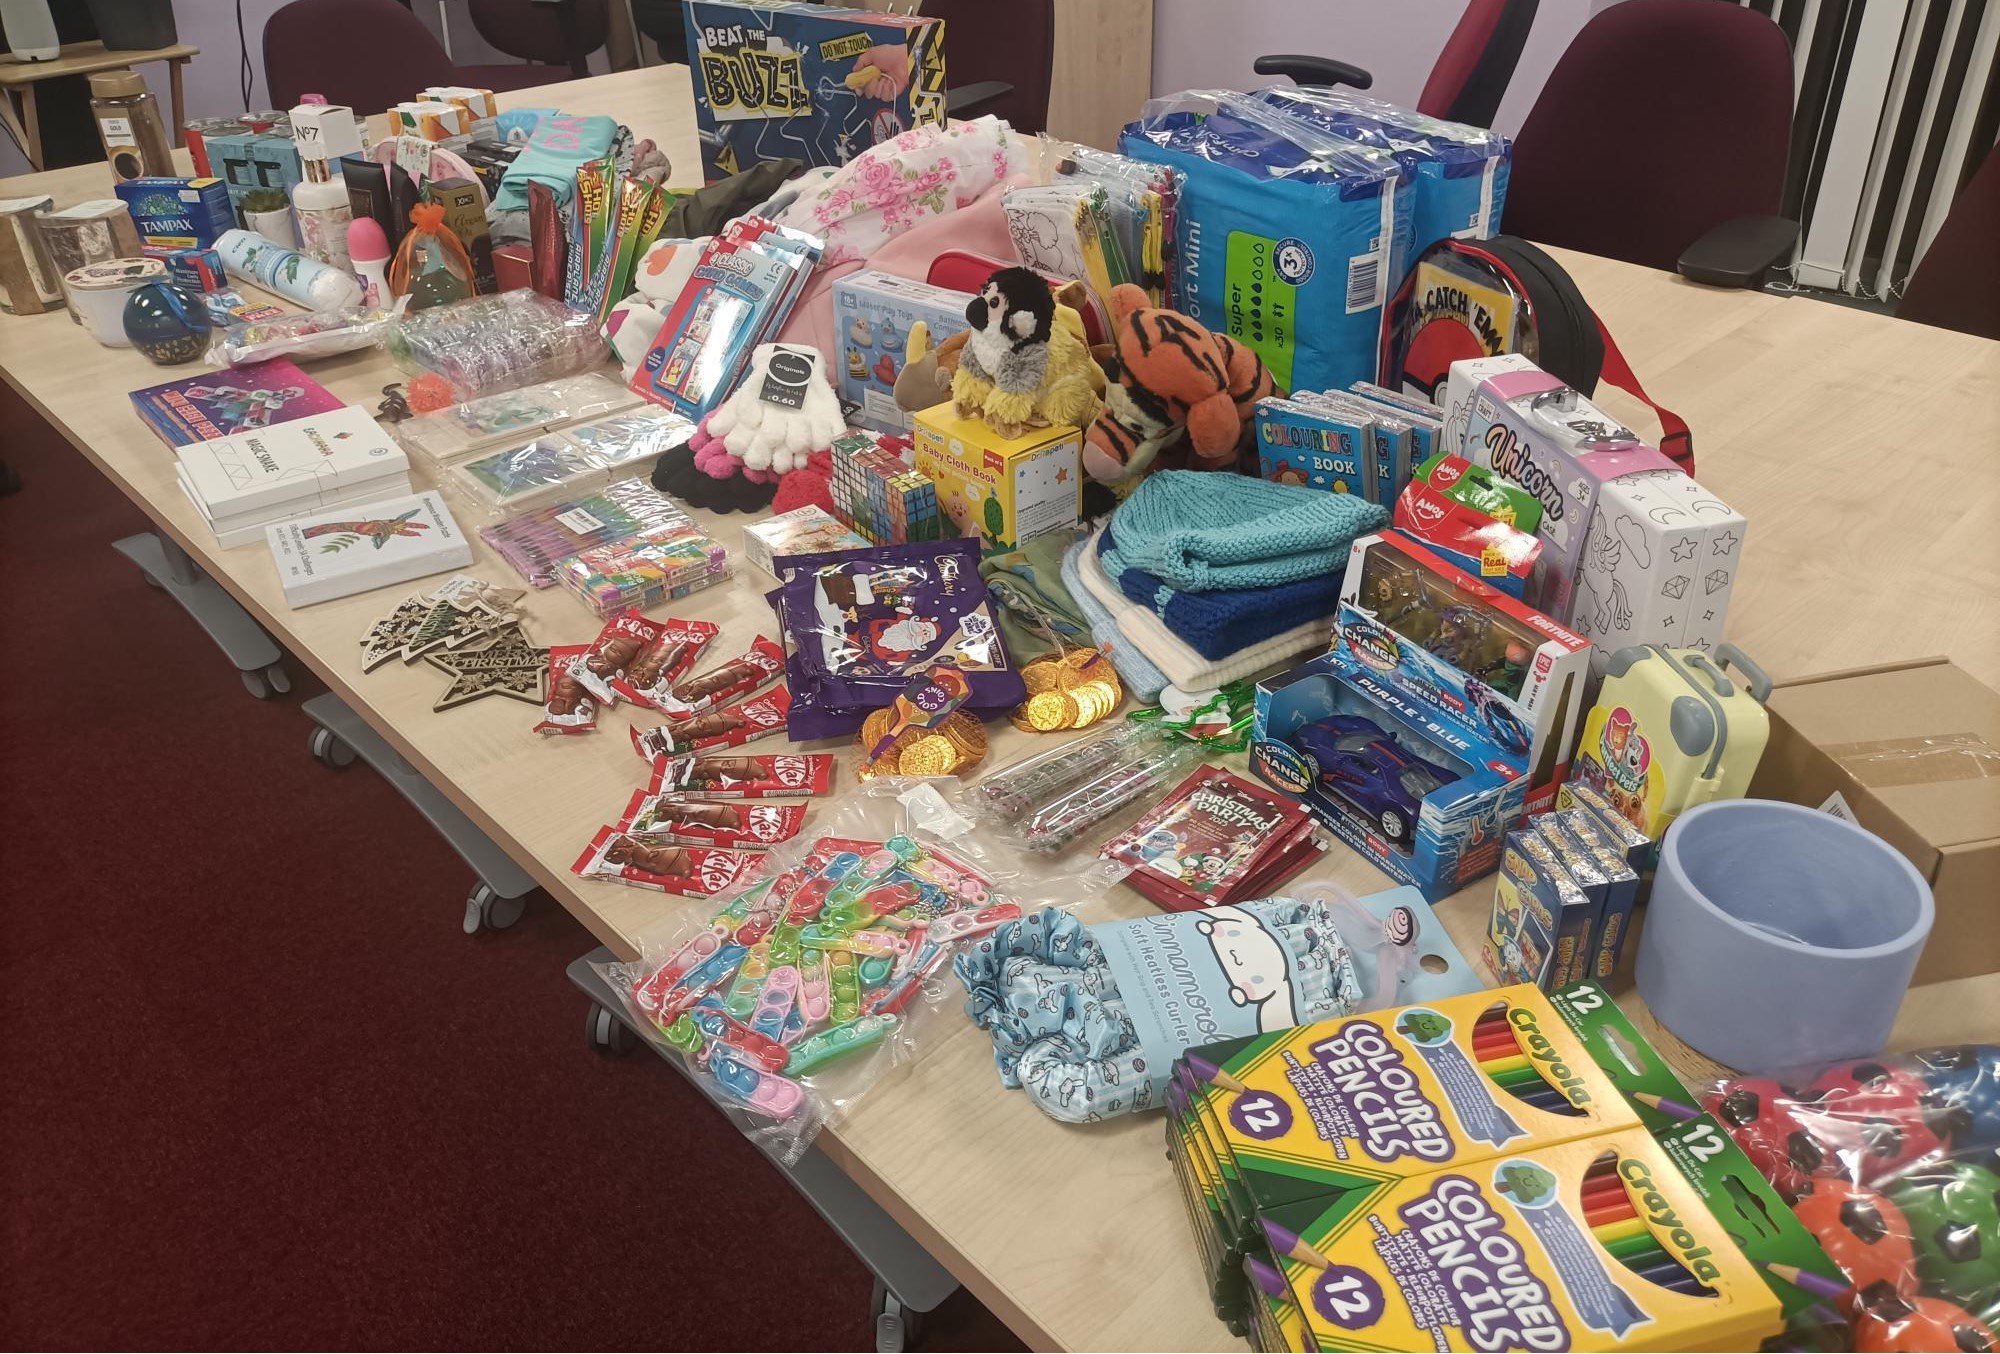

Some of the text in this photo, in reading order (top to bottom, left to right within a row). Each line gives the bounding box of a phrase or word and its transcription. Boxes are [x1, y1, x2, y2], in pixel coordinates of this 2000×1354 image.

[706, 25, 765, 47] BEAT THE
[822, 37, 873, 58] DO NOT TOUCH
[703, 51, 809, 109] BUZZ
[141, 218, 194, 233] TAMPAX
[717, 254, 754, 276] CLASSIC
[1186, 219, 1201, 277] Mini
[1275, 240, 1295, 255] SECURE
[571, 243, 583, 305] AIRPLANE
[725, 274, 764, 300] GAMES
[882, 305, 897, 318] Play
[898, 309, 913, 320] Toys
[1232, 283, 1243, 336] Super
[1426, 287, 1468, 315] CATCH
[775, 363, 805, 375] Originals
[1262, 422, 1354, 457] COLOURING
[923, 443, 996, 485] Baby Cloth Book
[1312, 456, 1356, 475] BOOK
[1437, 462, 1460, 480] AMOS
[1485, 424, 1563, 522] Unicorn
[1415, 499, 1445, 519] AMOS
[1483, 557, 1507, 567] Real
[1344, 627, 1399, 665] CHANGE
[1526, 615, 1584, 647] FORTNITE
[452, 656, 550, 669] CHRISTMAS
[475, 651, 538, 660] MERRY
[738, 650, 779, 670] KitKat
[741, 703, 780, 726] KitKat
[916, 686, 945, 710] GOLD COINS
[1357, 678, 1419, 717] PURPLE
[1425, 722, 1471, 750] BLUE
[1401, 678, 1479, 728] SPEED RACER
[774, 755, 806, 786] KitKat
[1255, 747, 1308, 789] CHANGE
[1265, 745, 1305, 767] COLOUR
[1495, 764, 1512, 776] 3+
[1264, 766, 1301, 792] RACERS
[1619, 775, 1639, 791] Pets
[1191, 792, 1270, 831] CHRISTMAS
[1197, 802, 1250, 827] PARTY
[1522, 792, 1554, 815] ORTNITE
[701, 850, 739, 891] KitKat
[1128, 924, 1191, 1046] Soft Heatless Curler
[1145, 913, 1238, 1046] Cinnamorol
[1566, 985, 1603, 1015] 12
[1509, 1007, 1592, 1105] Crayola
[1283, 1051, 1348, 1160] BUNTSTIFTE KLEURPOTLODEN
[1305, 1066, 1349, 1137] MATITE COLORATE
[1311, 1062, 1337, 1095] CRAYONS
[1338, 1103, 1361, 1138] COULEUR
[1315, 1037, 1411, 1157] PENCILS
[1344, 1023, 1450, 1158] COLOURED
[1240, 1097, 1281, 1133] 12
[1308, 1106, 1330, 1140] COLORES
[1682, 1124, 1725, 1163] 12
[1620, 1158, 1721, 1283] Crayola
[1394, 1235, 1449, 1325] MATITE COLORATE
[1401, 1228, 1433, 1269] CRAYONS
[1434, 1282, 1462, 1327] COULEUR
[1404, 1198, 1520, 1351] PENCILS
[1437, 1179, 1564, 1350] COLOURED
[1324, 1274, 1370, 1320] 12
[1368, 1215, 1450, 1354] BUNTSTIFTE KLEURPOTLODEN
[1402, 1286, 1428, 1330] COLORES
